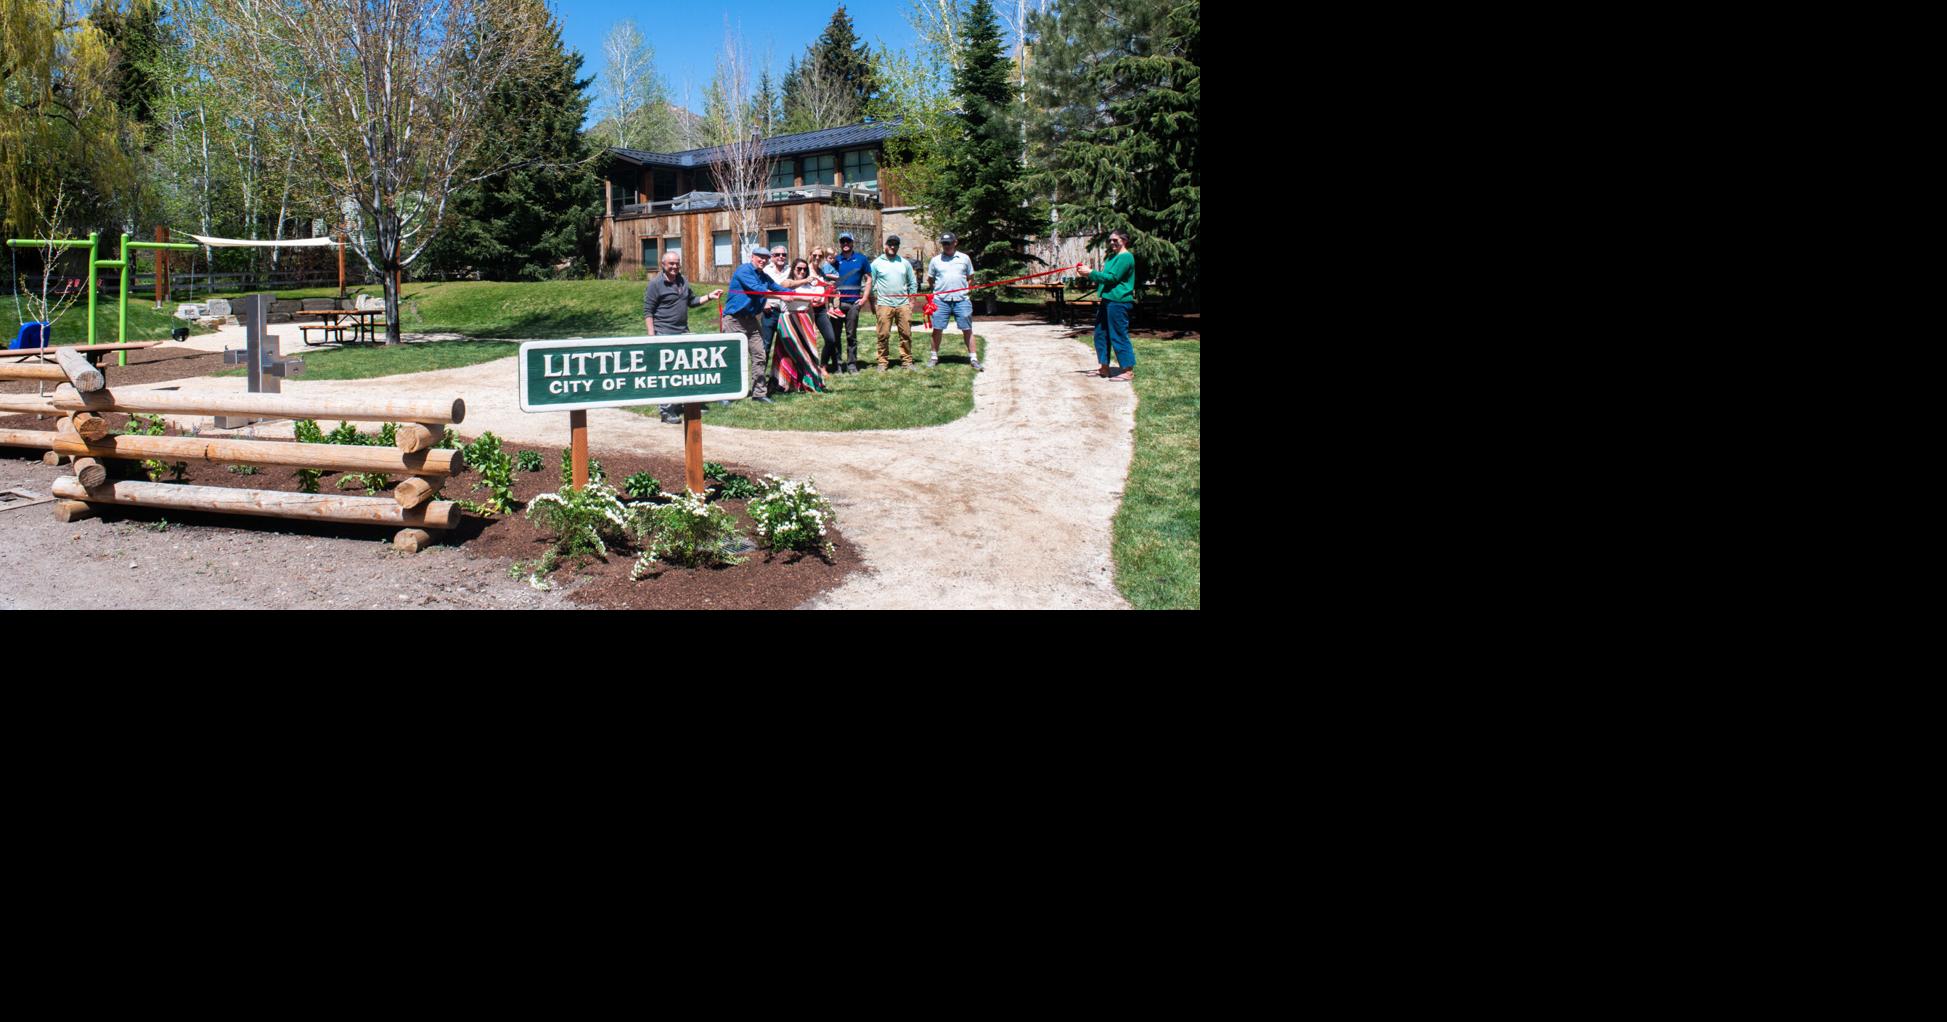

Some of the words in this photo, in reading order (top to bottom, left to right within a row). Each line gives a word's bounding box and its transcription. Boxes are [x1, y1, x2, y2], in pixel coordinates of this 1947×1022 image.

[543, 349, 647, 378] LITTLE
[658, 346, 728, 372] PARK
[549, 379, 594, 394] CITY
[602, 377, 626, 391] OF
[634, 372, 721, 389] KETCHUM
